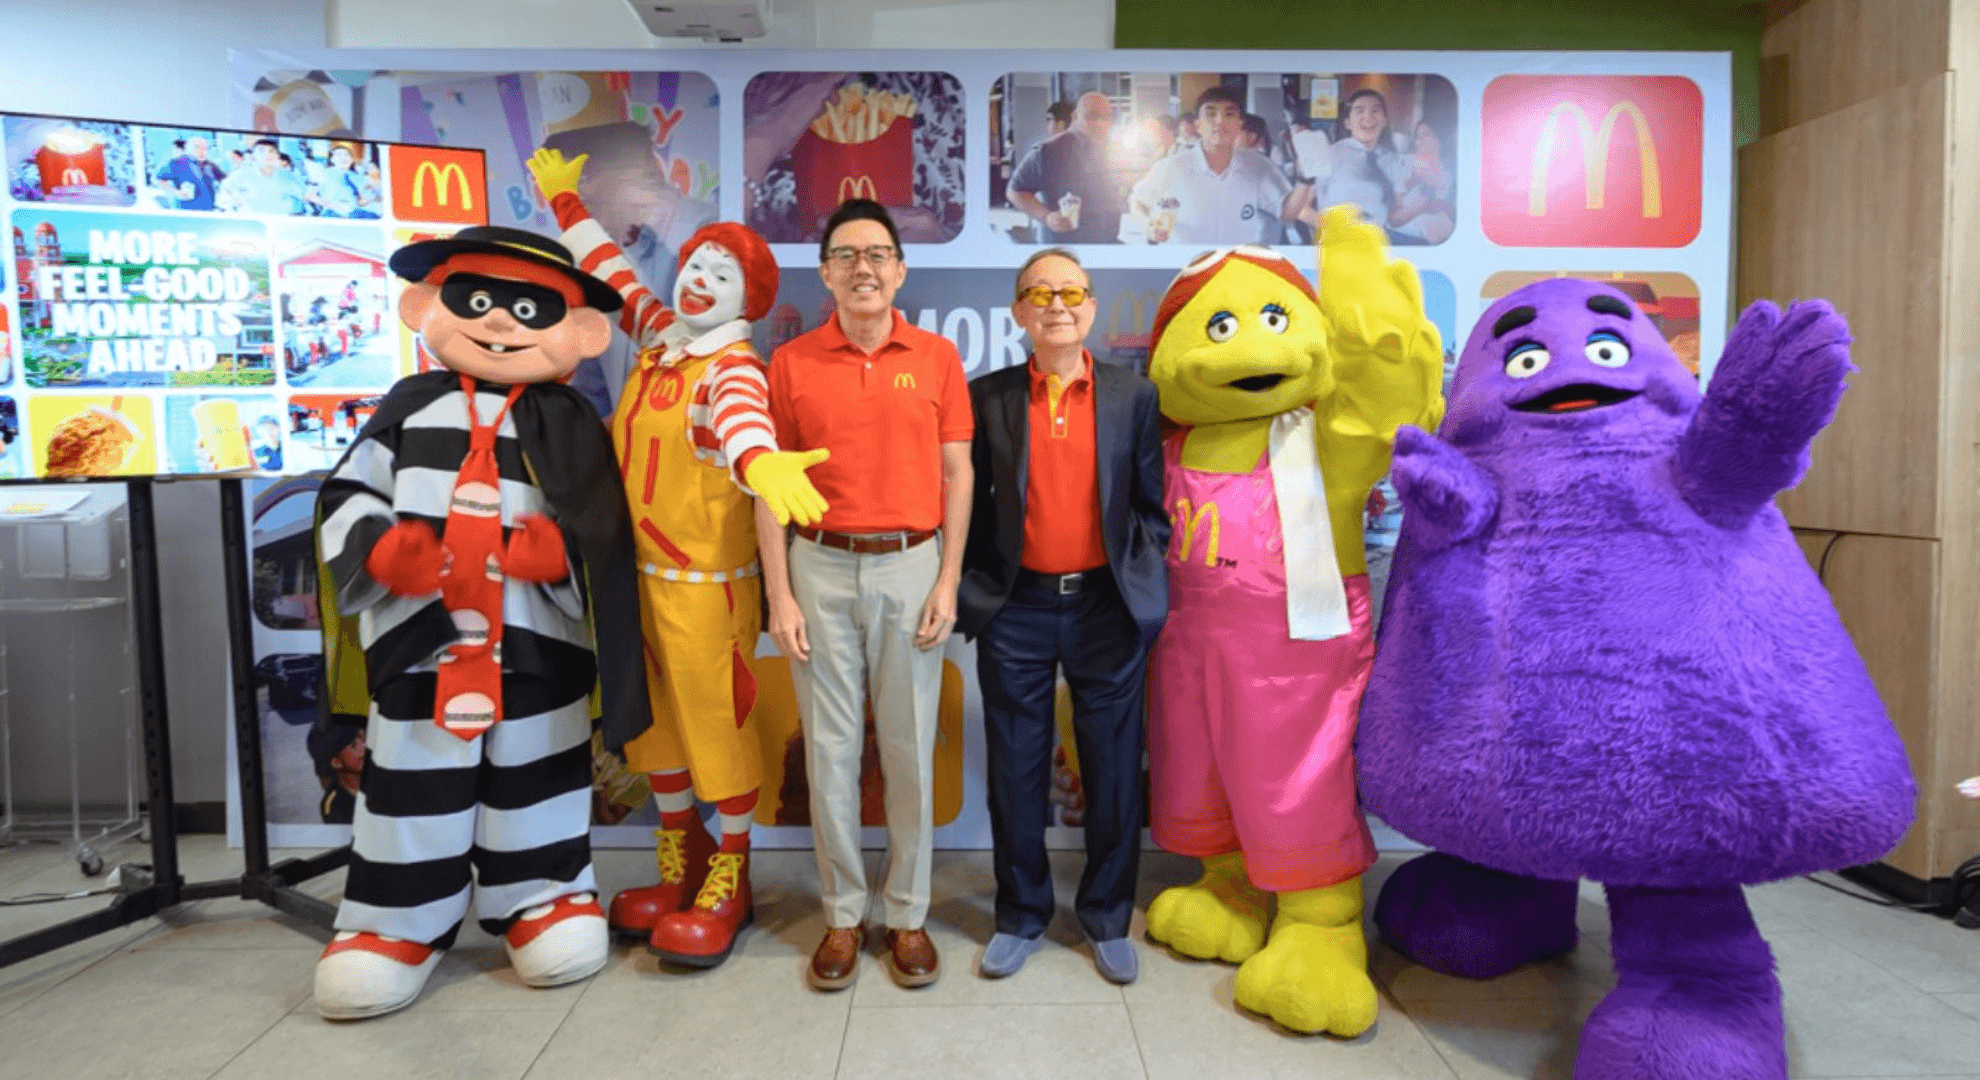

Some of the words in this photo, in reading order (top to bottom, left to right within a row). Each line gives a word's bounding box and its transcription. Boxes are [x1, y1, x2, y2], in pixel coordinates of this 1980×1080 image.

[1527, 100, 1663, 219] M
[413, 160, 472, 210] M
[89, 230, 199, 265] MORE
[39, 266, 250, 301] FEEL-GOOD
[52, 302, 243, 337] MOMENTS
[87, 338, 217, 374] AHEAD
